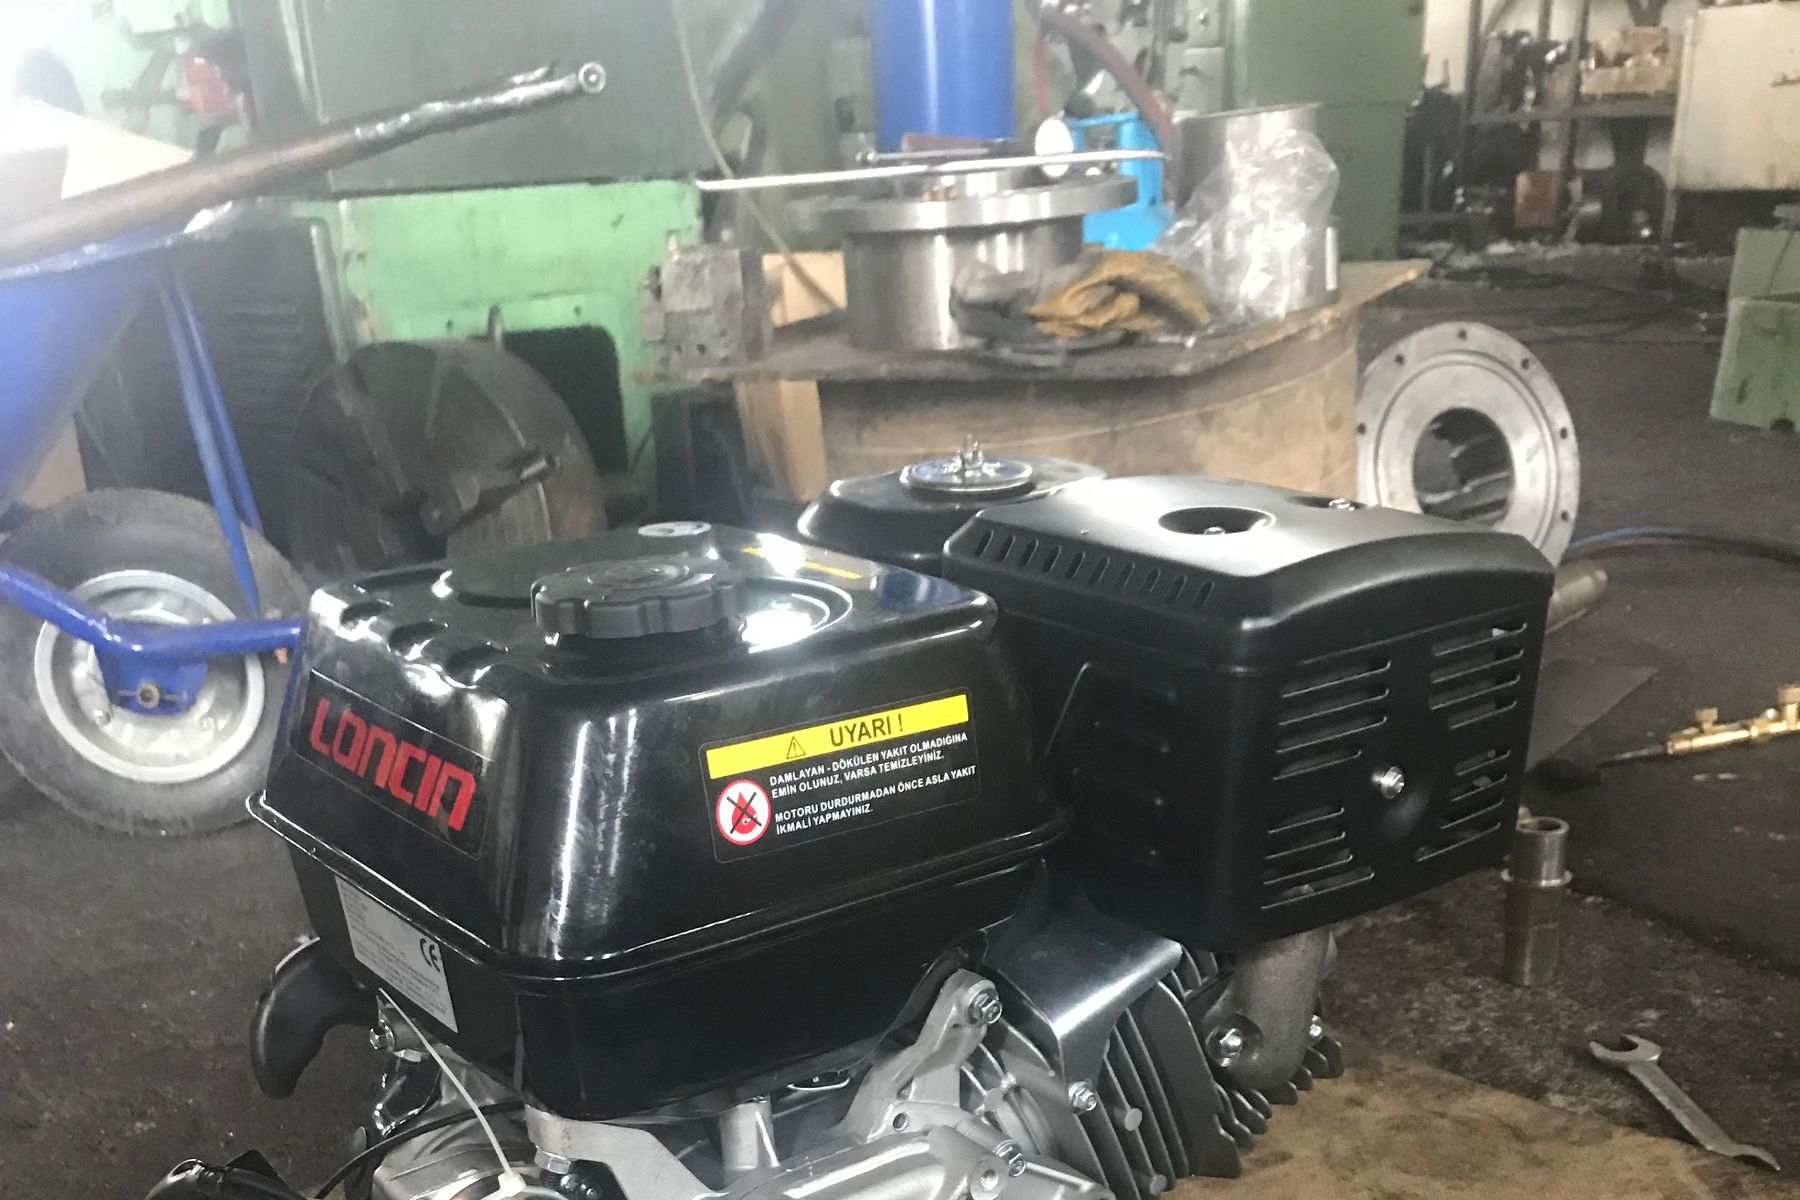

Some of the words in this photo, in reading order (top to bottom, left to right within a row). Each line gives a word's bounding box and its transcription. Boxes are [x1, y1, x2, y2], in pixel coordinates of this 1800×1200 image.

[829, 716, 892, 746] UYARI
[310, 697, 477, 832] LONCIN
[770, 764, 825, 786] DAMLAYAN
[832, 752, 879, 772] DÖKÜLEN
[881, 745, 908, 760] YAKIT
[909, 732, 968, 754] OLMADIĞINA
[771, 784, 797, 799] EMİN
[799, 774, 843, 792] OLUNUZ,
[844, 765, 877, 781] VARSA
[879, 750, 945, 774] TEMİZLEYİNİZ.
[774, 805, 819, 823] MOTORU
[820, 785, 896, 812] DURDURMADAN
[897, 778, 924, 793] ÖNCE
[925, 772, 950, 786] ASLA
[951, 765, 976, 780] YAKIT
[776, 816, 812, 835] İKMALİ
[813, 802, 874, 826] YAPMAYINIZ.
